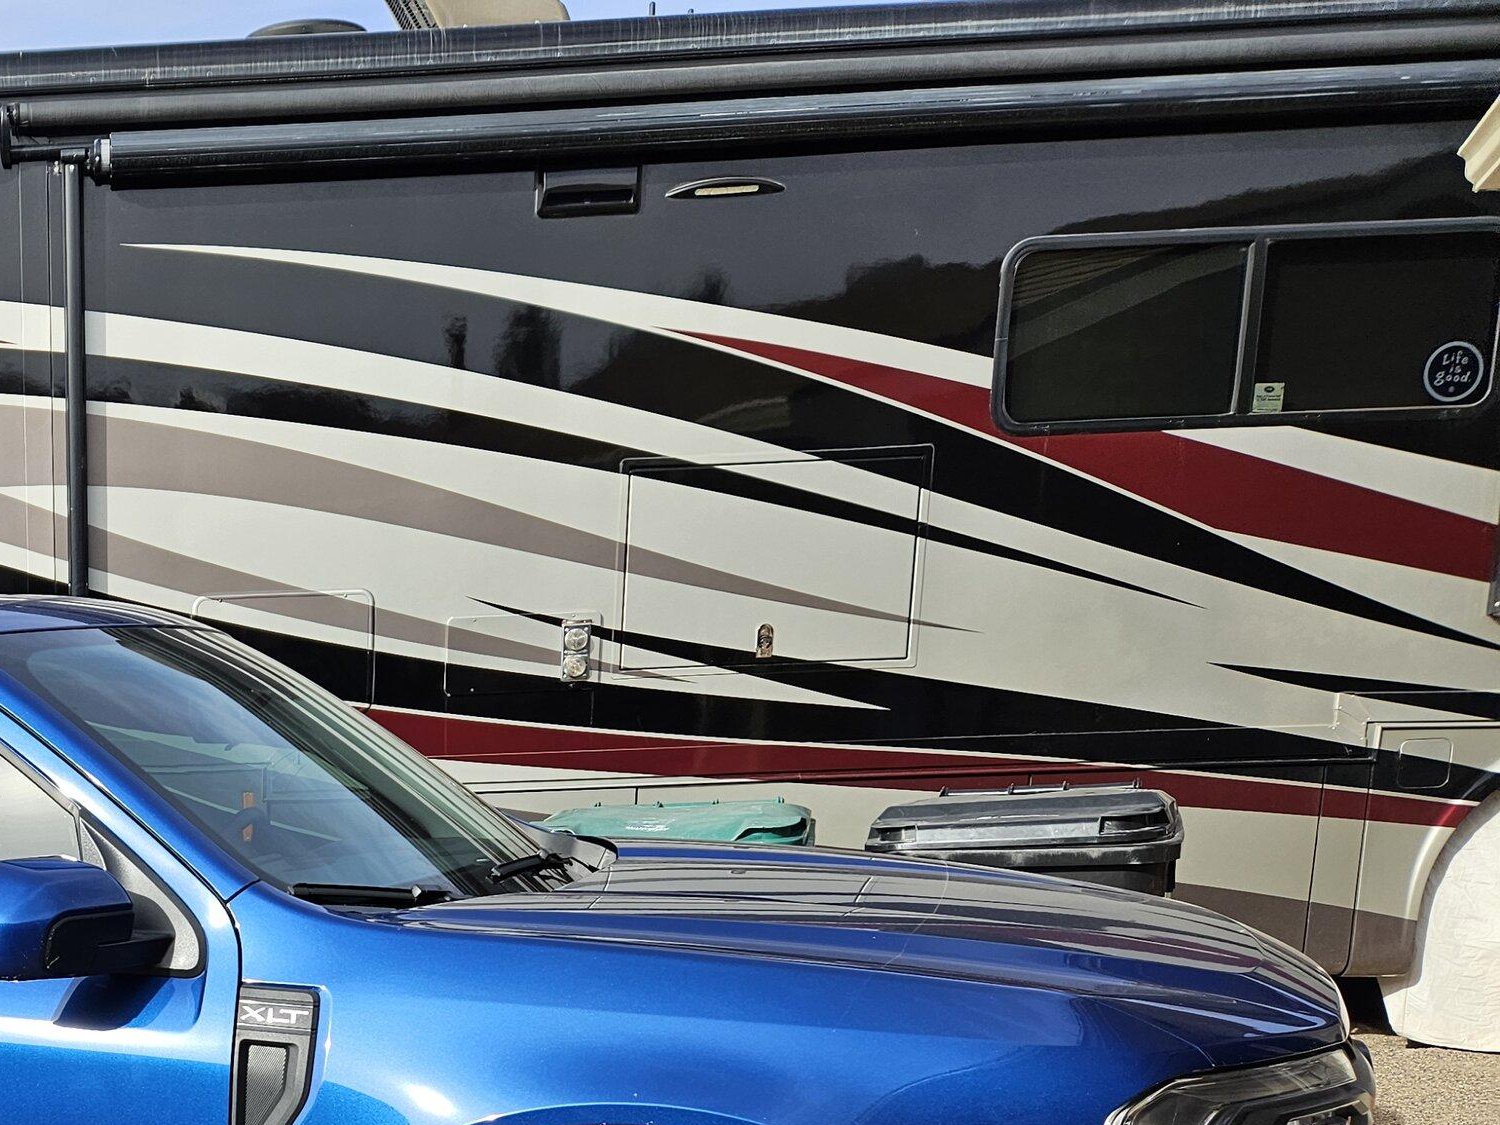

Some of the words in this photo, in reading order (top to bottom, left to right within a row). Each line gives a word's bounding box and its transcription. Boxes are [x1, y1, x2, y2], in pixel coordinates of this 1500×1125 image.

[1442, 350, 1469, 365] Life
[1449, 364, 1461, 373] is
[240, 1005, 310, 1024] XLT
